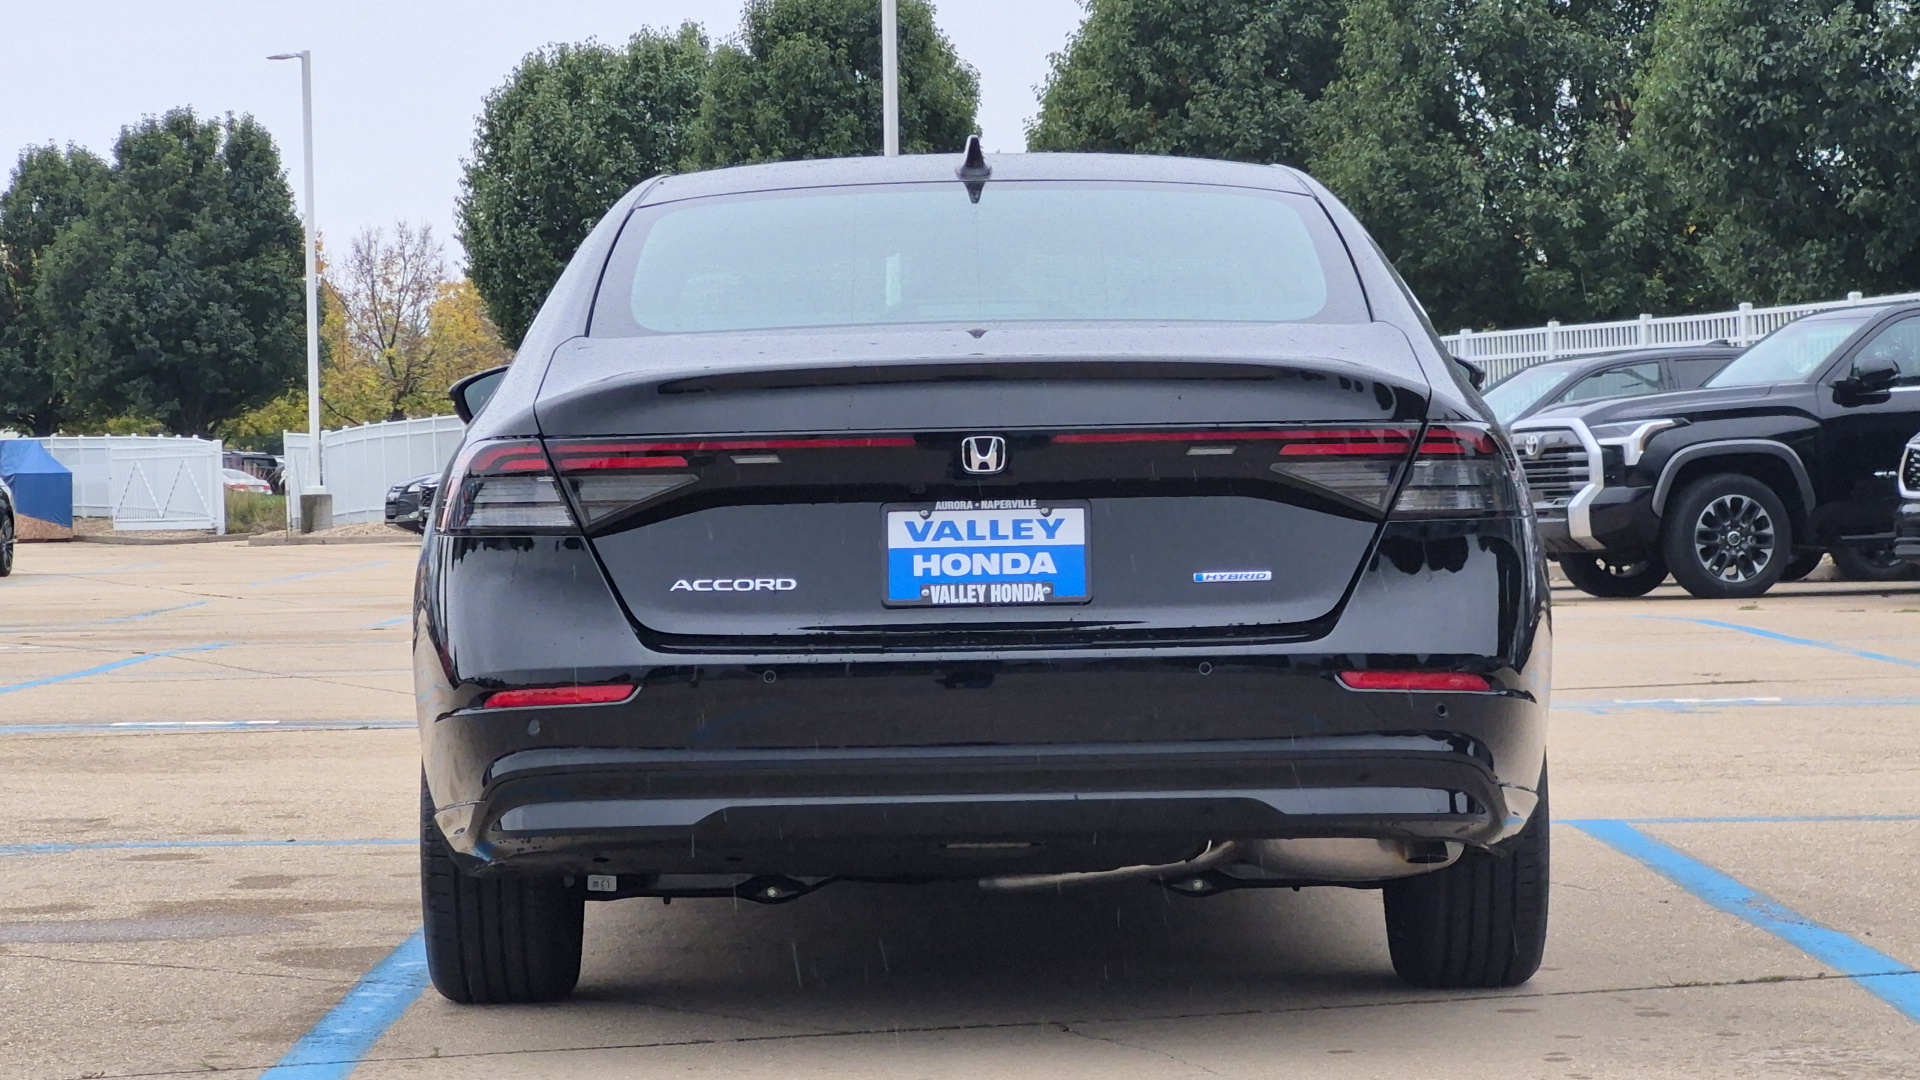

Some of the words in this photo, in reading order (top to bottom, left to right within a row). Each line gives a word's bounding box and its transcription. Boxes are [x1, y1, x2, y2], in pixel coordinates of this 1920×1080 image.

[935, 500, 973, 511] AURORA
[980, 499, 1037, 510] NAPERVILLE
[904, 518, 1066, 542] VALLEY
[913, 551, 1058, 577] HONDA
[669, 578, 797, 592] ACCORD
[1205, 572, 1267, 581] HYBRID
[930, 584, 987, 604] VALLEY
[990, 582, 1045, 603] HONDA
